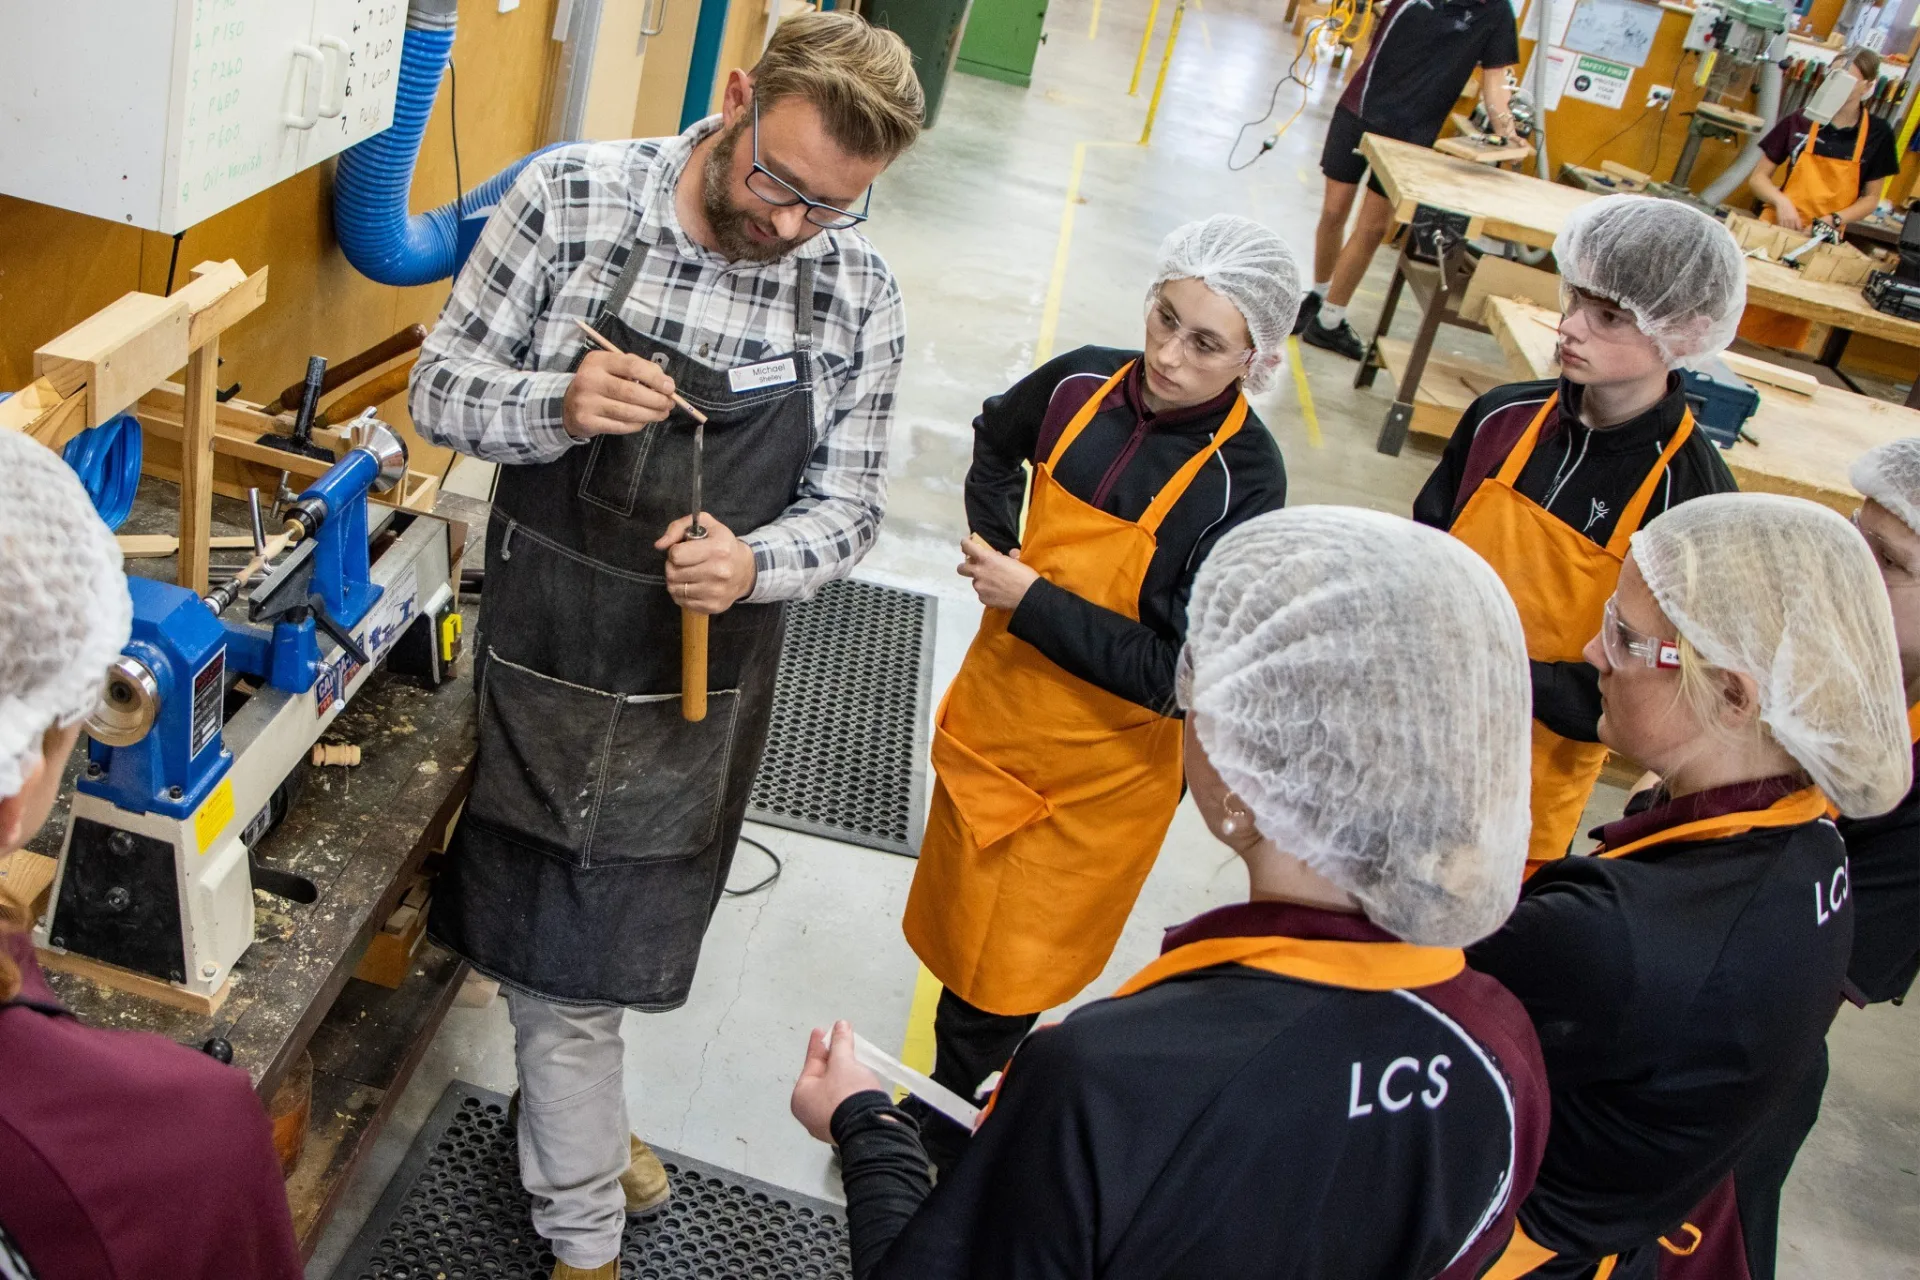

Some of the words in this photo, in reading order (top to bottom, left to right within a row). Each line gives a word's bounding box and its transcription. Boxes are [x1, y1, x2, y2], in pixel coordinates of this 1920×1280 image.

[752, 364, 785, 376] Michael
[759, 374, 782, 384] Shelley
[1348, 1054, 1452, 1119] LCS
